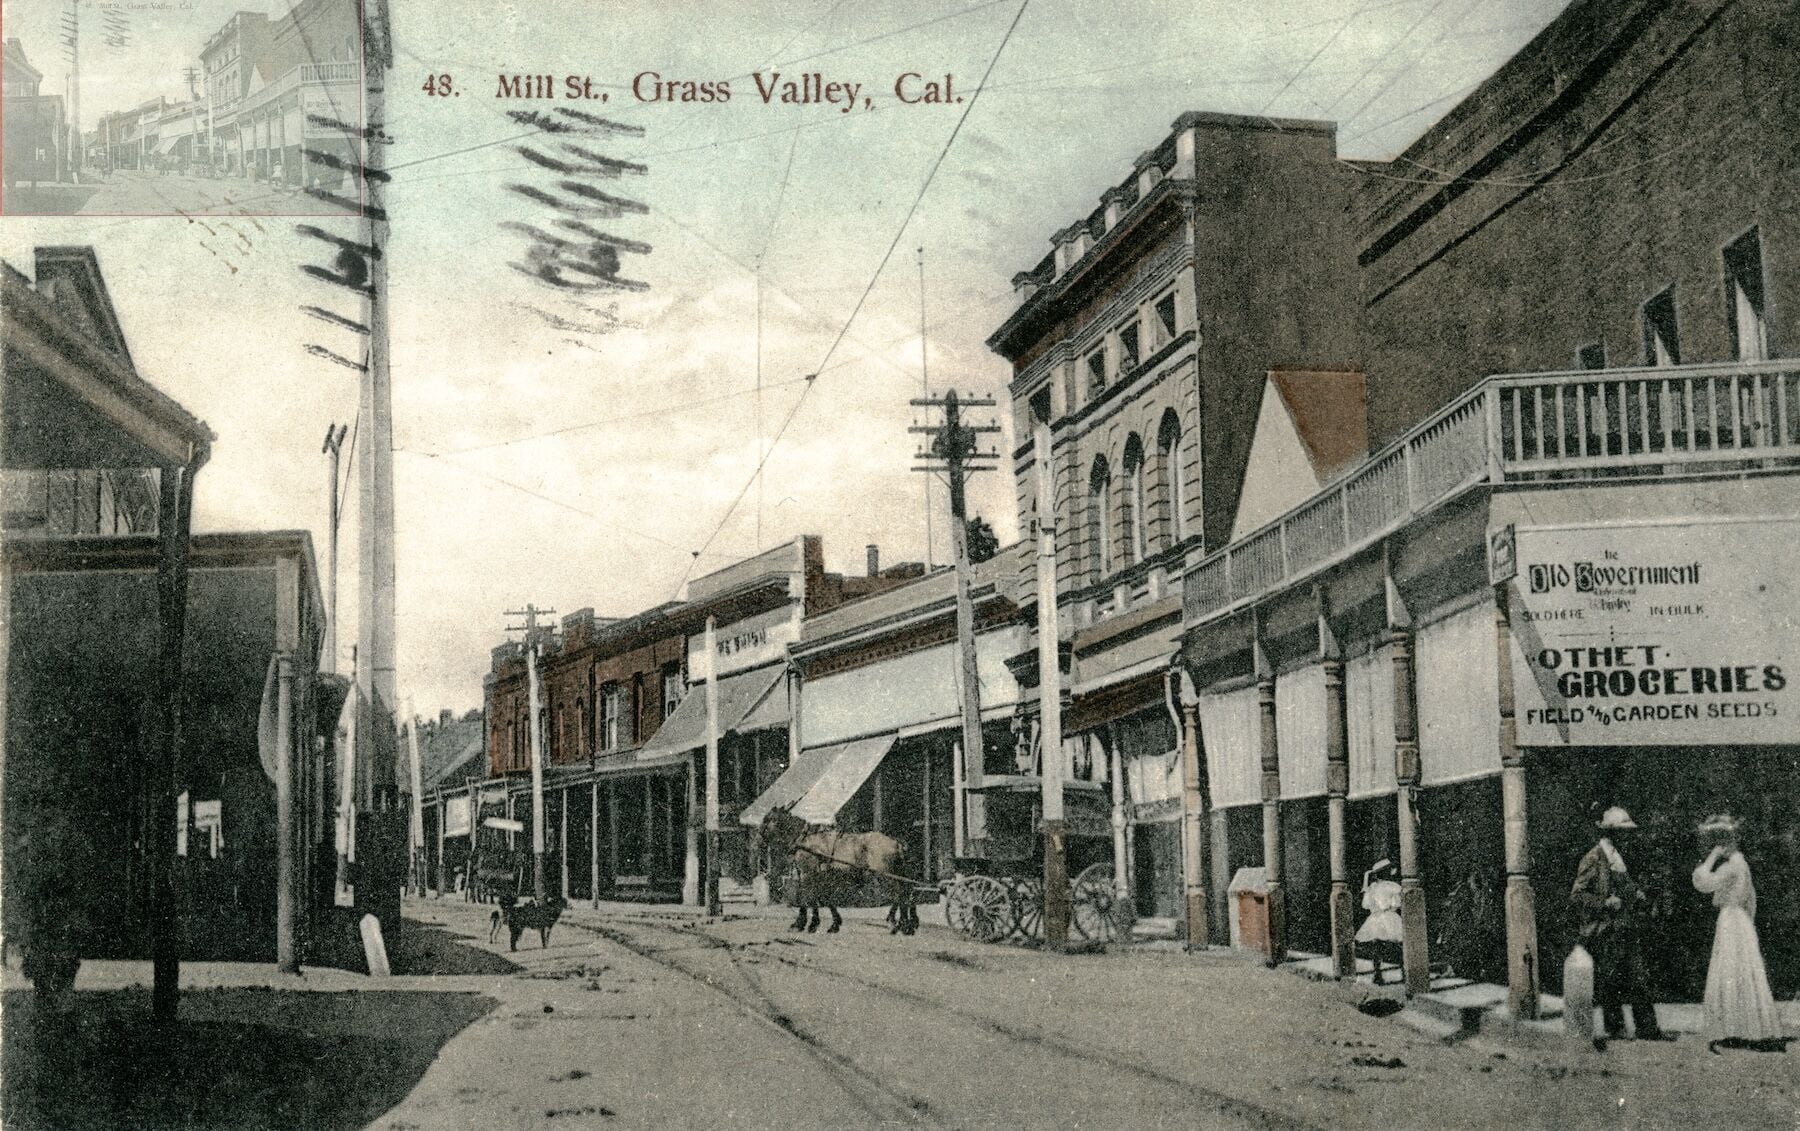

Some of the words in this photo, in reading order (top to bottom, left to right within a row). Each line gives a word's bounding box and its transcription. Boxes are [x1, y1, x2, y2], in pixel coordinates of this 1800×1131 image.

[1529, 564, 1570, 593] Old
[1574, 561, 1702, 593] Government
[1557, 665, 1787, 698] GROCERIES
[1527, 708, 1584, 725] FIELD
[1612, 704, 1699, 722] GARDEN
[1707, 702, 1778, 719] SEEDS
